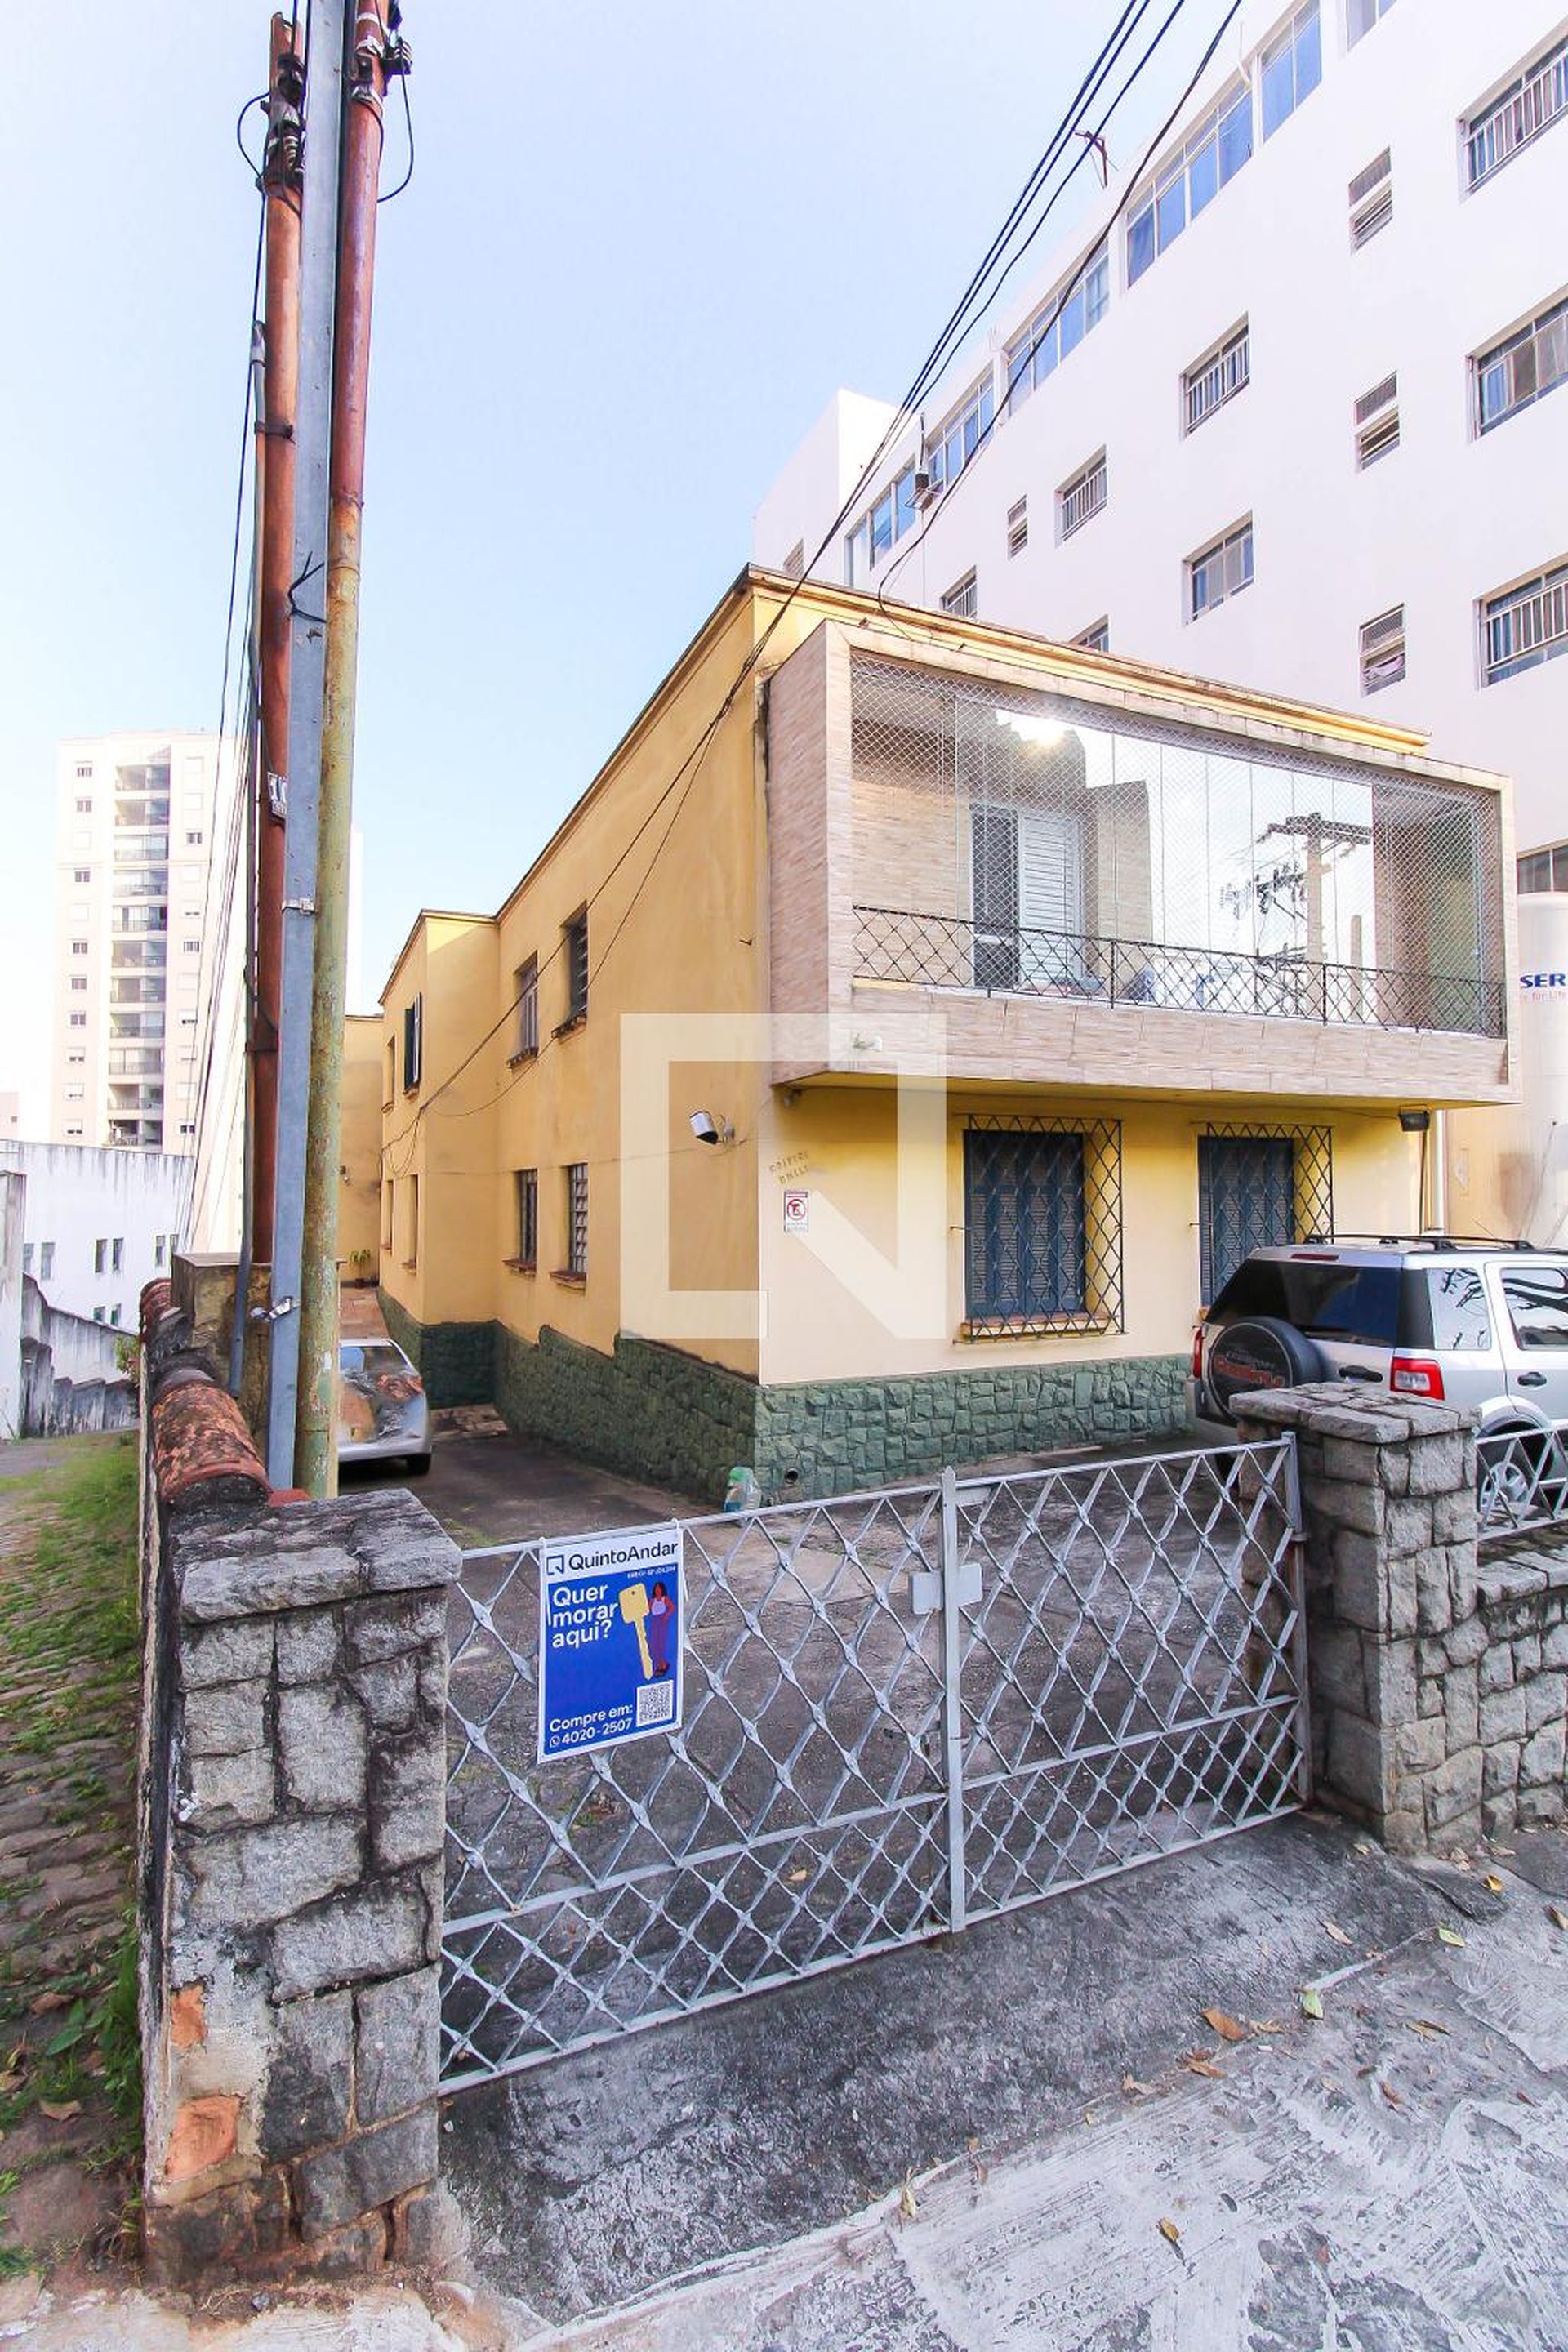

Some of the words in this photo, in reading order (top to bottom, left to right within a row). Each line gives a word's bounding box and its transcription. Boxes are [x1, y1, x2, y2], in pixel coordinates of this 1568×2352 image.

[1519, 973, 1566, 988] SER
[568, 1542, 679, 1570] QuintoAndar
[553, 1584, 608, 1607] Quer
[552, 1602, 618, 1628] morar
[552, 1619, 612, 1649] aqui?
[550, 1711, 606, 1732] Compre
[608, 1704, 634, 1718] em:
